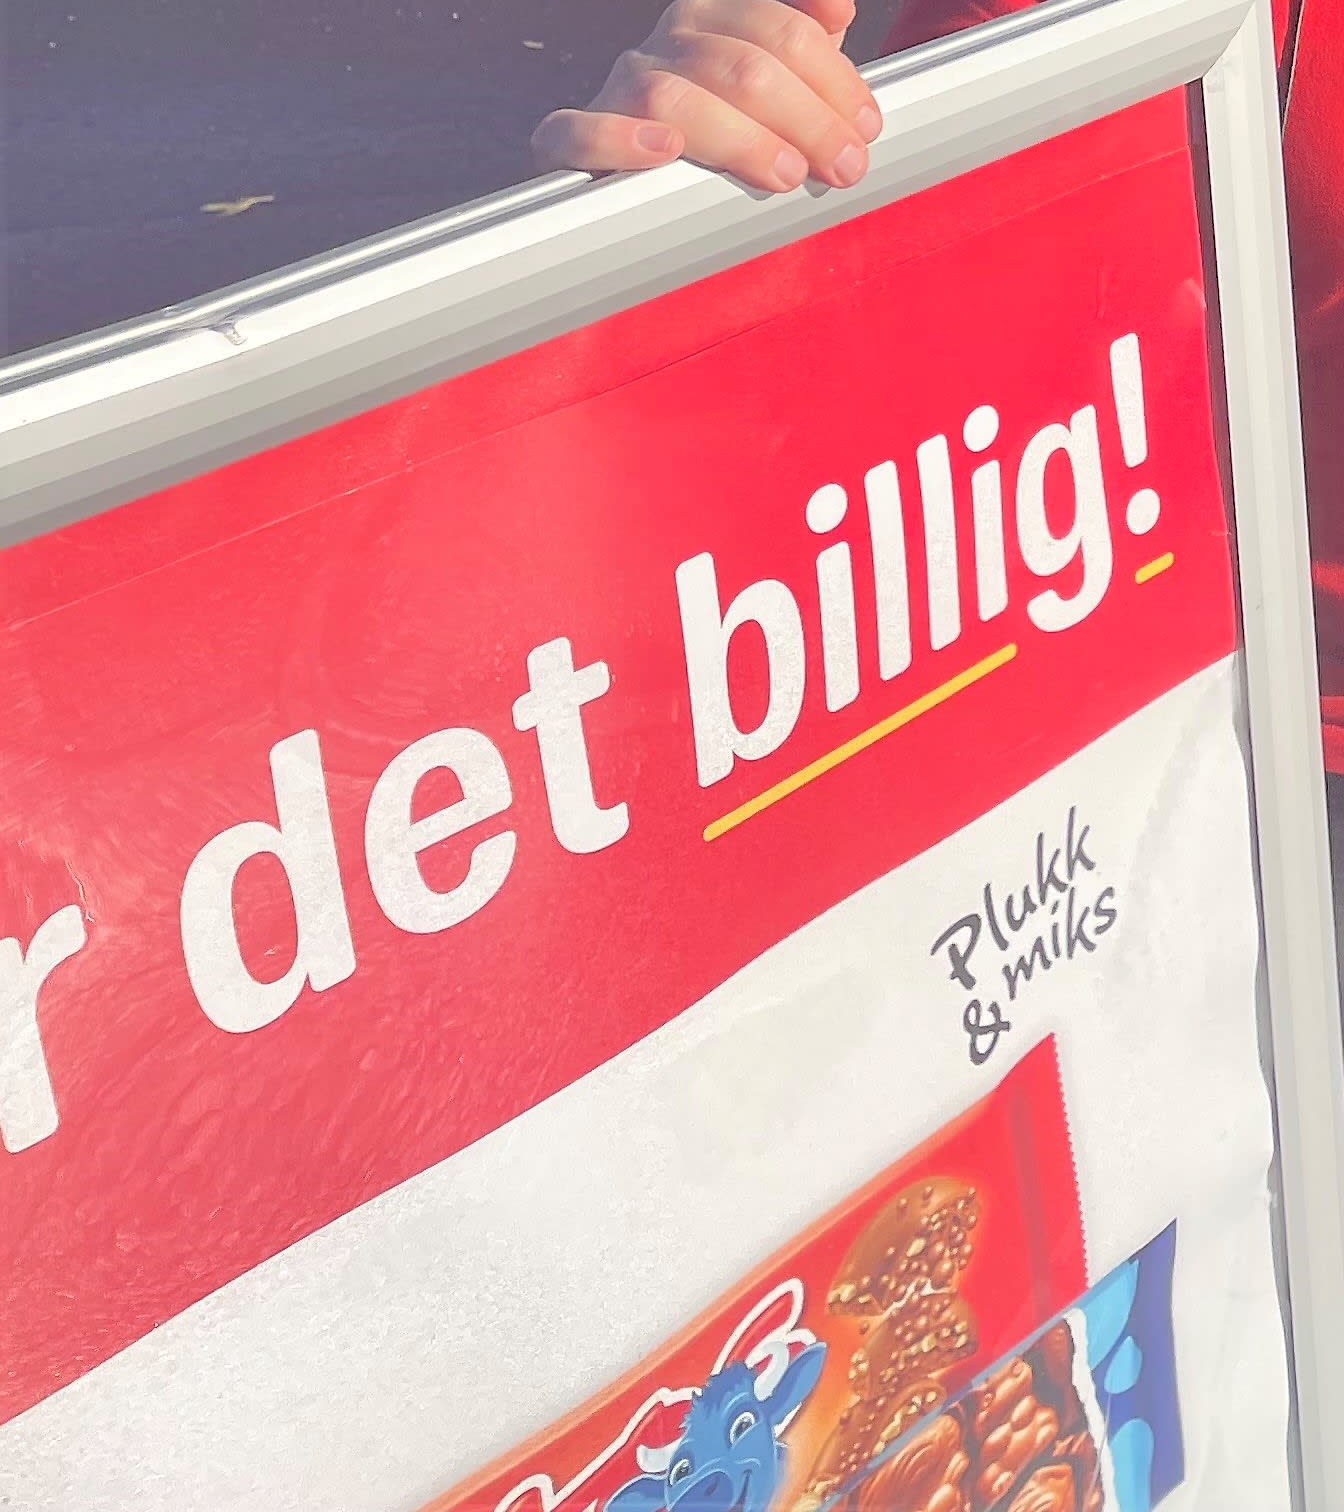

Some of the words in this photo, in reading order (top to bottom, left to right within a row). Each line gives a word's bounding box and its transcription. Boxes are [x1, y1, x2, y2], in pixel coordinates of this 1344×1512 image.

[181, 637, 630, 1035] det
[674, 333, 1164, 789] billig!
[930, 805, 1096, 990] Plukk
[963, 999, 1011, 1066] &
[1002, 887, 1117, 1000] miks
